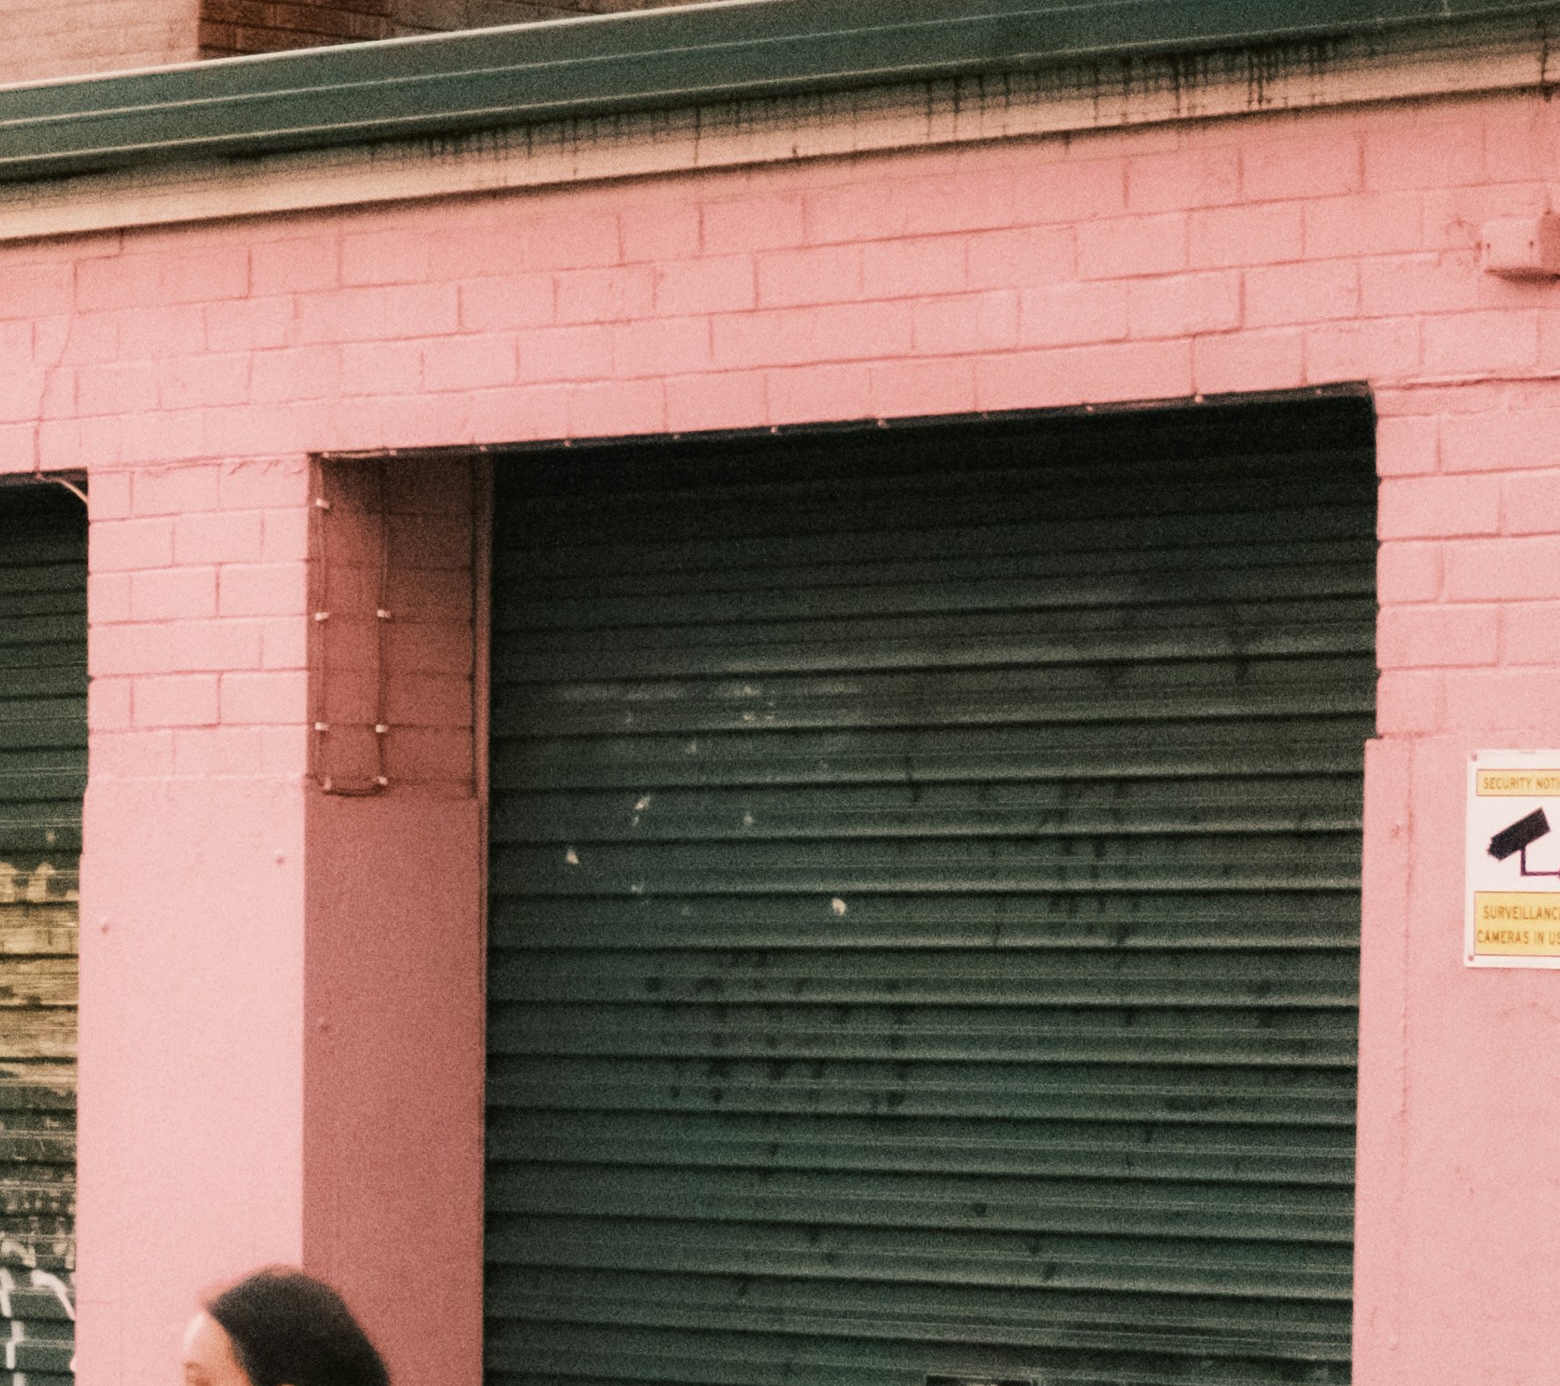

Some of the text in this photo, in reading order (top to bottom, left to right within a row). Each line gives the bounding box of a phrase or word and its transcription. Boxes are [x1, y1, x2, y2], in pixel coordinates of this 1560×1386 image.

[1482, 776, 1532, 790] SECURITY
[1476, 929, 1530, 945] CAMERAS
[1533, 930, 1545, 946] IN
